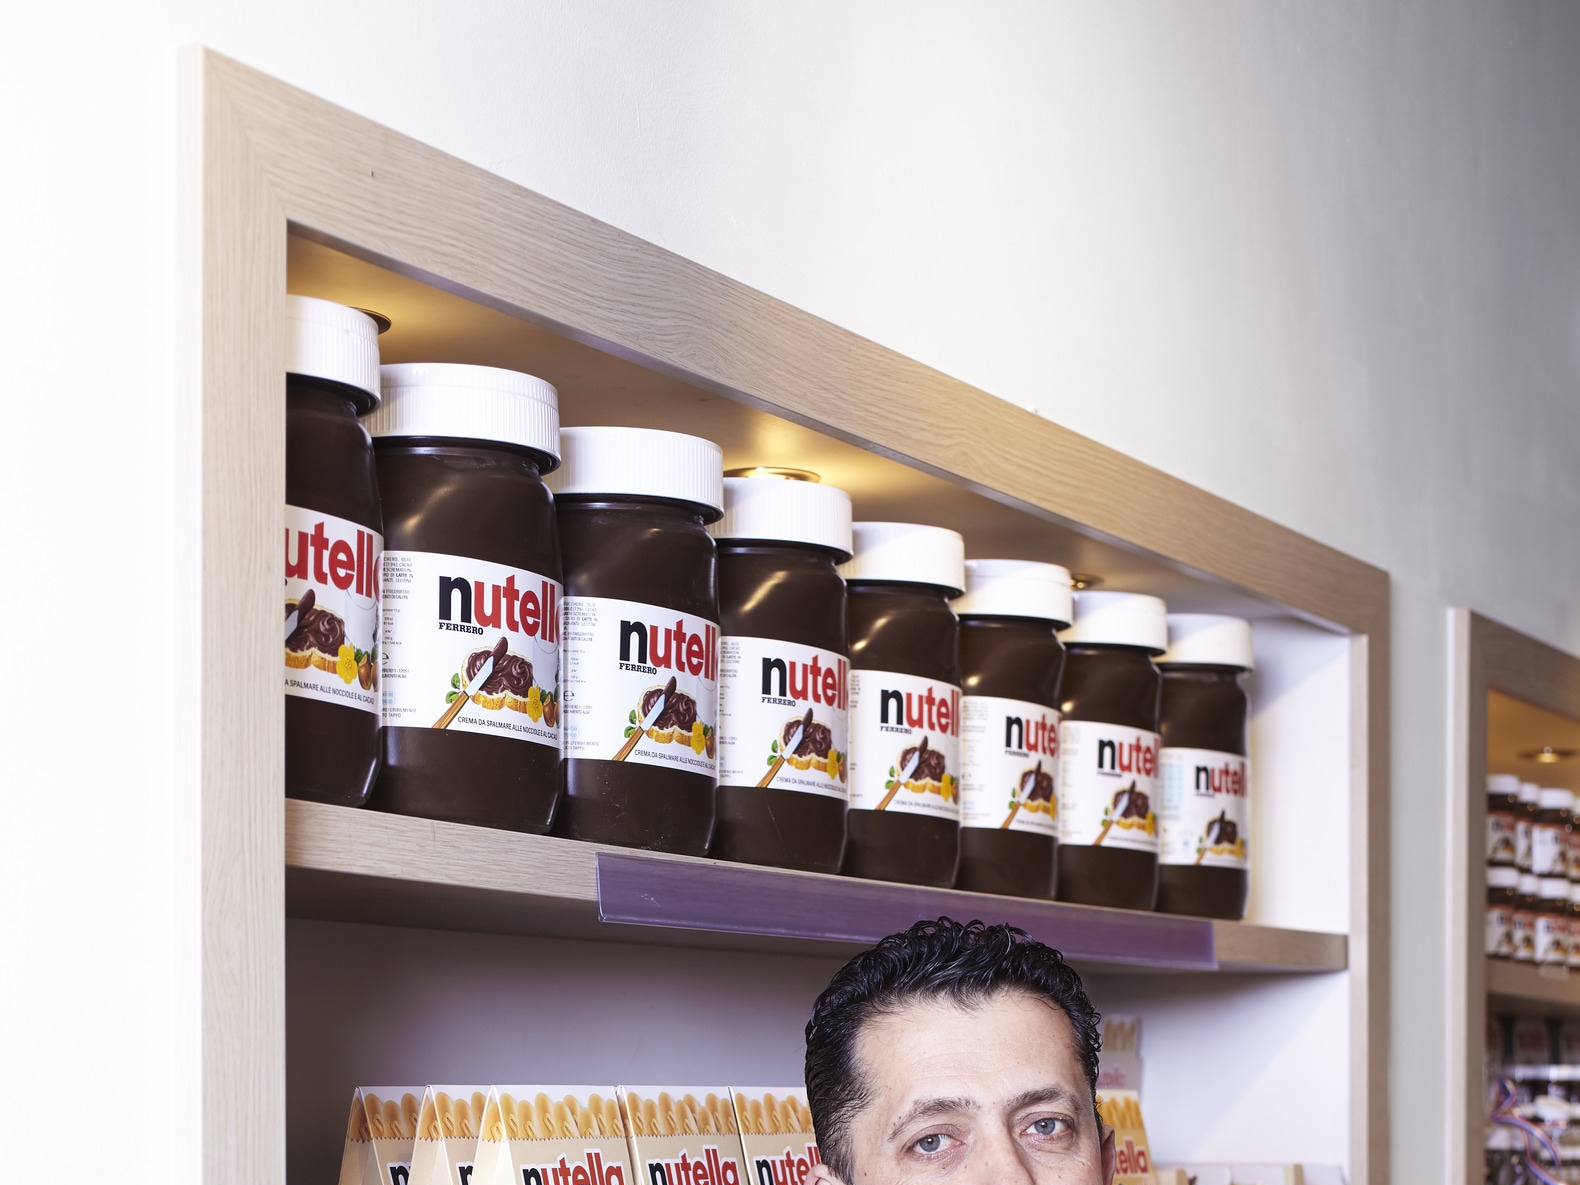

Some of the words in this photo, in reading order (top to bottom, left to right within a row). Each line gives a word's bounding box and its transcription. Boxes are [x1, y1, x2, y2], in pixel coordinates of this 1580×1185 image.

[285, 521, 380, 603] utell
[439, 574, 560, 648] nutell
[439, 621, 484, 635] FERRERO
[619, 618, 718, 682] nutell
[619, 662, 657, 675] FERRERO
[762, 653, 849, 711] nutell
[290, 680, 319, 691] SPALMARE
[319, 685, 332, 694] ALLE
[332, 688, 354, 700] NOCCIOLE
[761, 696, 797, 708] FERRERO
[457, 716, 478, 725] CREMA
[478, 718, 486, 726] DA
[486, 720, 512, 730] SPALMARE
[511, 724, 523, 733] ALLE
[880, 686, 960, 738] nutell
[634, 749, 651, 757] CREMA
[1005, 712, 1060, 759] nute
[1116, 1139, 1149, 1175] ella
